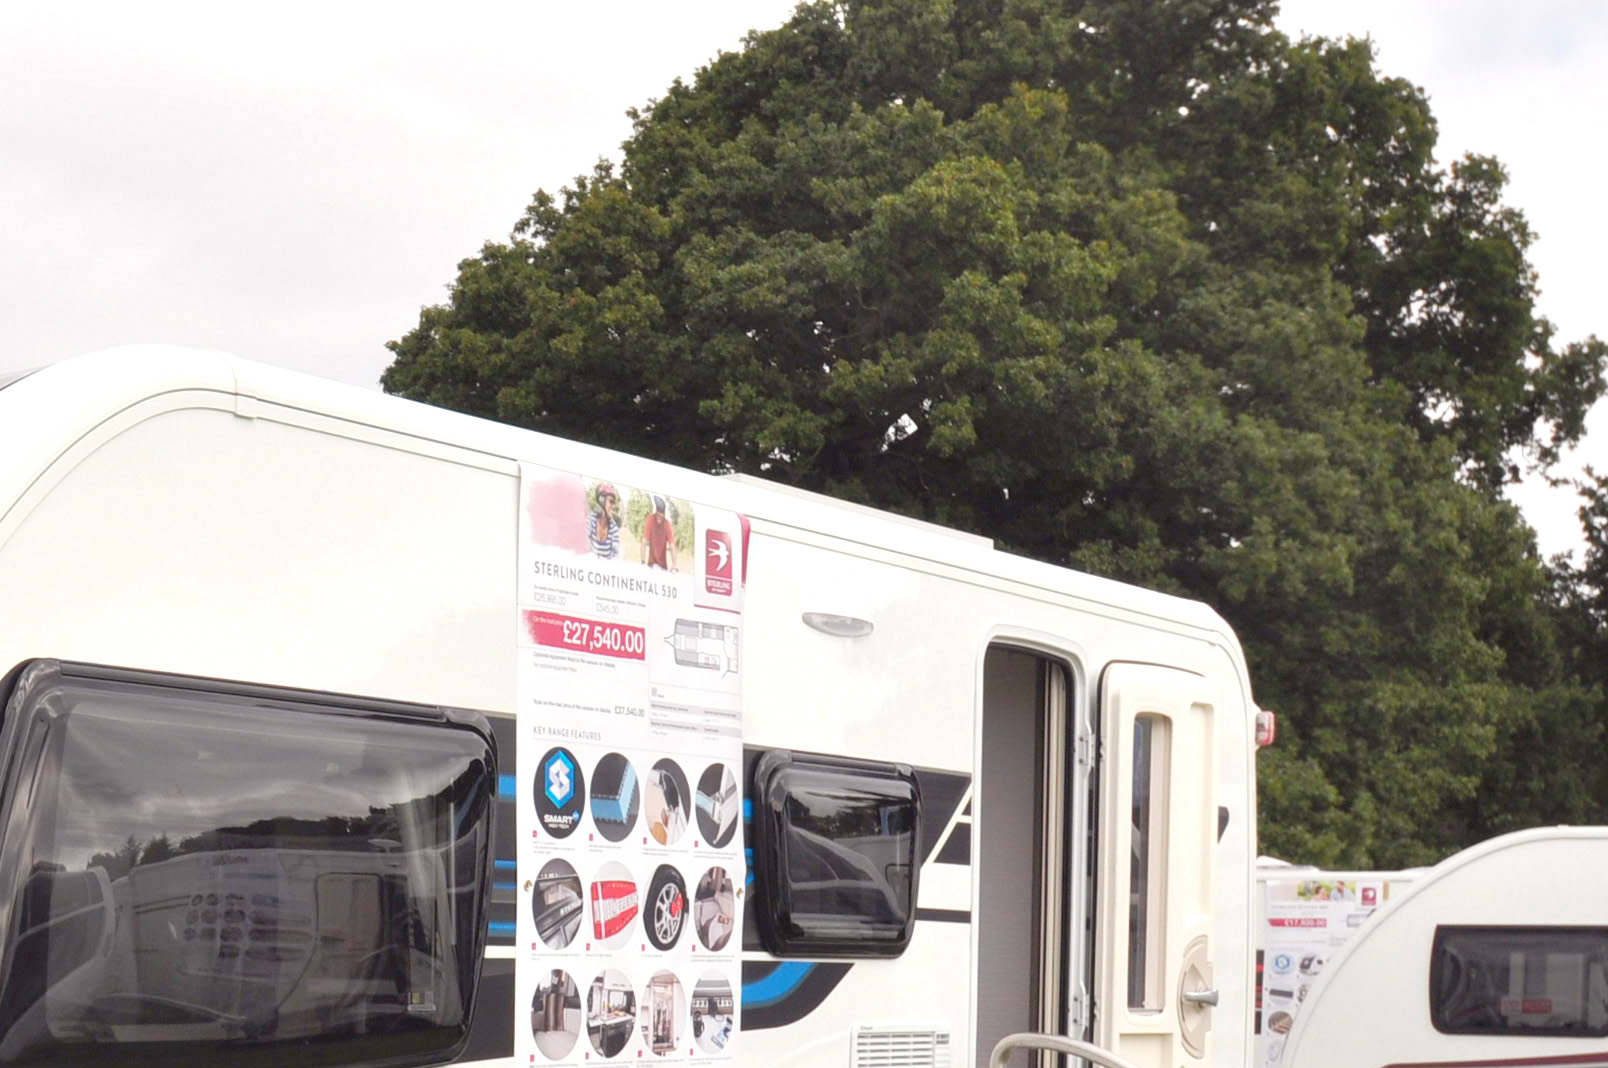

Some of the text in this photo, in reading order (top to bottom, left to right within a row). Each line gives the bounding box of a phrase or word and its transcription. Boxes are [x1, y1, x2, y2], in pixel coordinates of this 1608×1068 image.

[534, 561, 584, 582] STERLING
[588, 571, 659, 596] CONTINENTAL
[662, 584, 678, 599] 530
[563, 620, 644, 654] £27,540.00
[533, 726, 601, 741] KEY RANGE FEATURES
[543, 814, 573, 825] SMART
